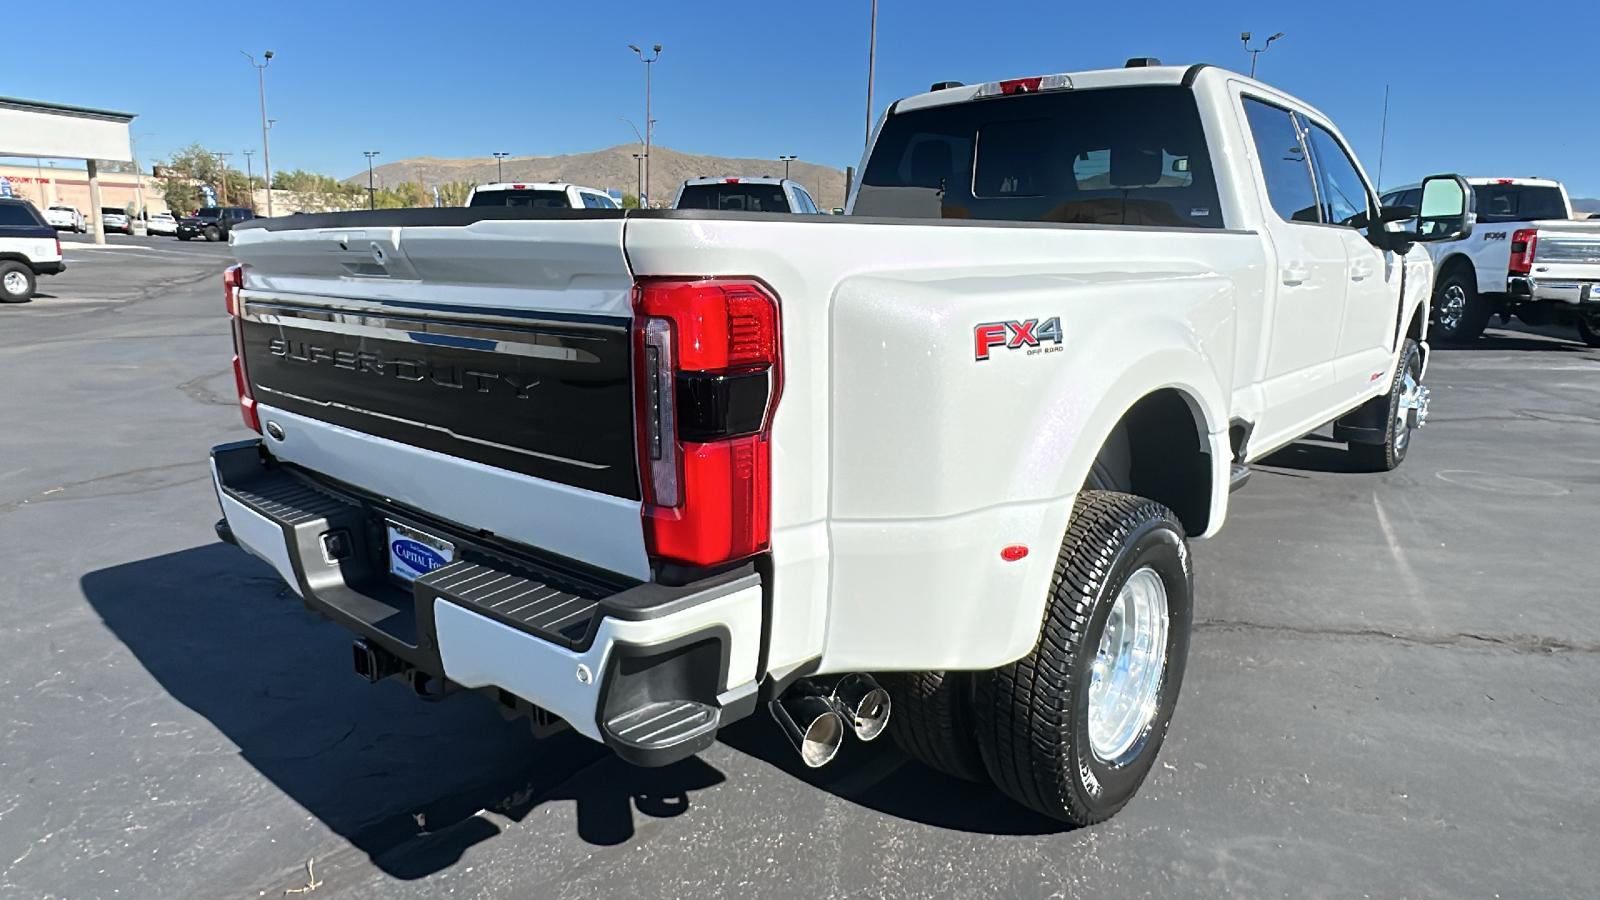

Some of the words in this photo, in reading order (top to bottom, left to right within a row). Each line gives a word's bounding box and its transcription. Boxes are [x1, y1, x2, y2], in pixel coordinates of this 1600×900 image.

[974, 316, 1063, 362] FX4
[1026, 348, 1042, 356] OFF
[1044, 346, 1064, 354] ROAD
[269, 338, 384, 376] SUPER
[391, 357, 541, 399] DUTY
[396, 544, 428, 567] CAPITAL
